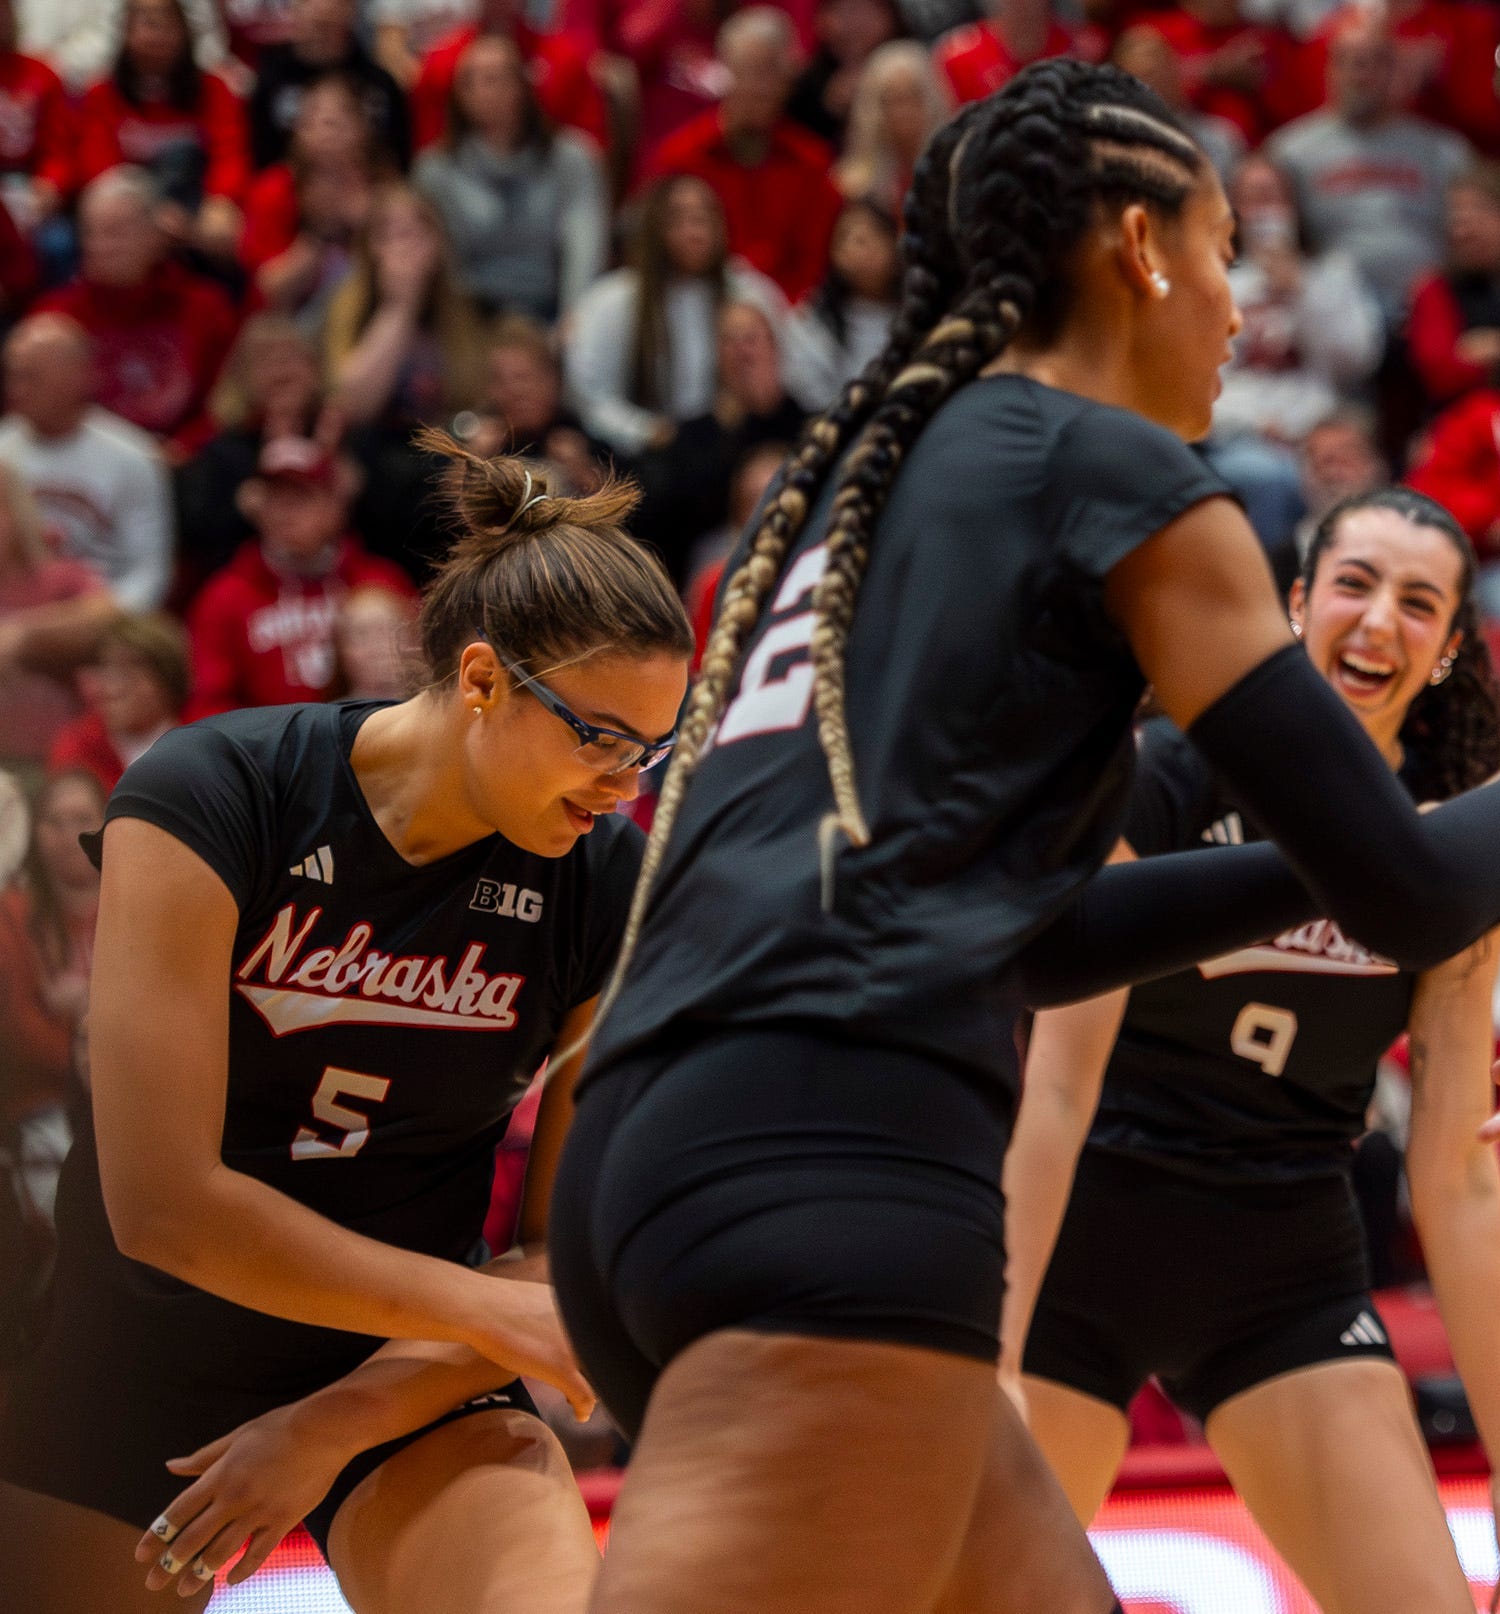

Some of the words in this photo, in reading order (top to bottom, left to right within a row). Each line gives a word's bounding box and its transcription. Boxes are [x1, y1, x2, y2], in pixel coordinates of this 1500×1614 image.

[234, 901, 526, 1036] Nebraska
[1230, 1001, 1298, 1078] 9
[289, 1064, 392, 1161] 5
